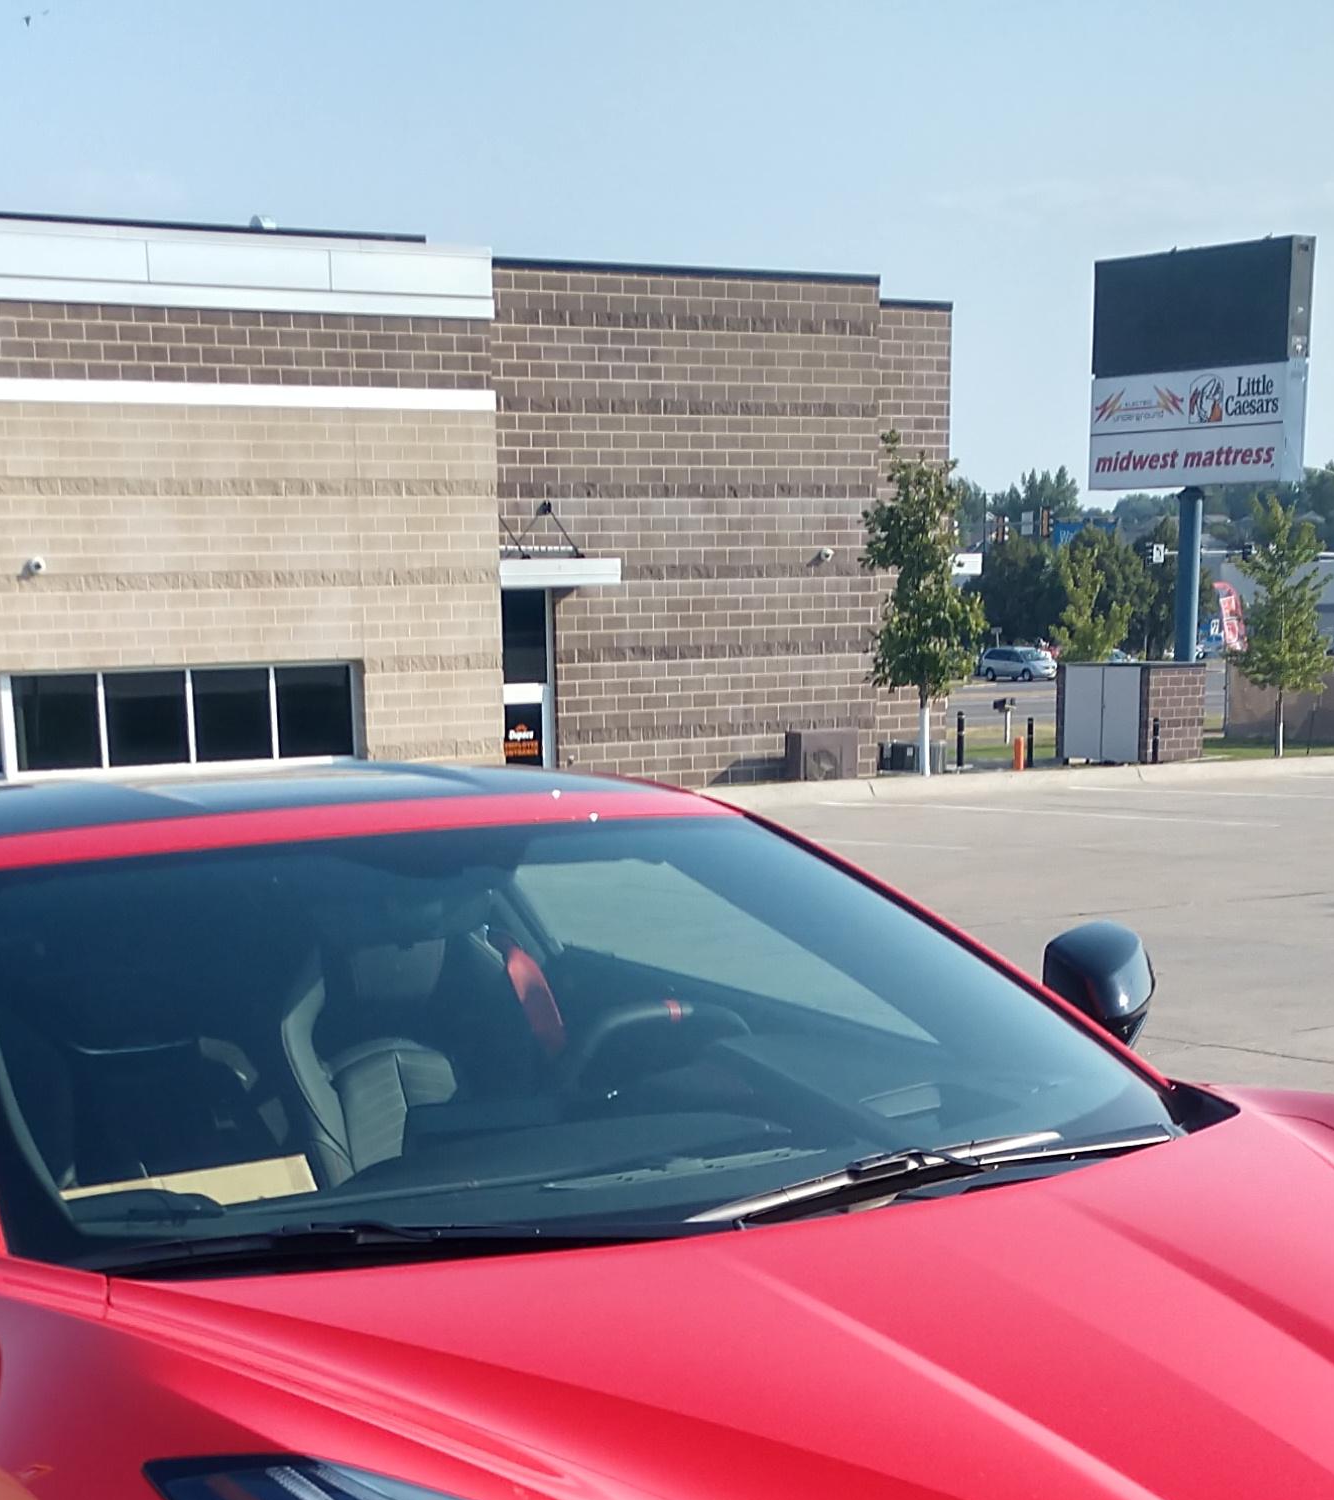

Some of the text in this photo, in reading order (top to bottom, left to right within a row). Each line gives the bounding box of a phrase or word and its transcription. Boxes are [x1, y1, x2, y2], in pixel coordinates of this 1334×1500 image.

[1236, 373, 1274, 398] Little
[1225, 395, 1280, 417] Caesars
[1095, 445, 1276, 473] midwest mattress
